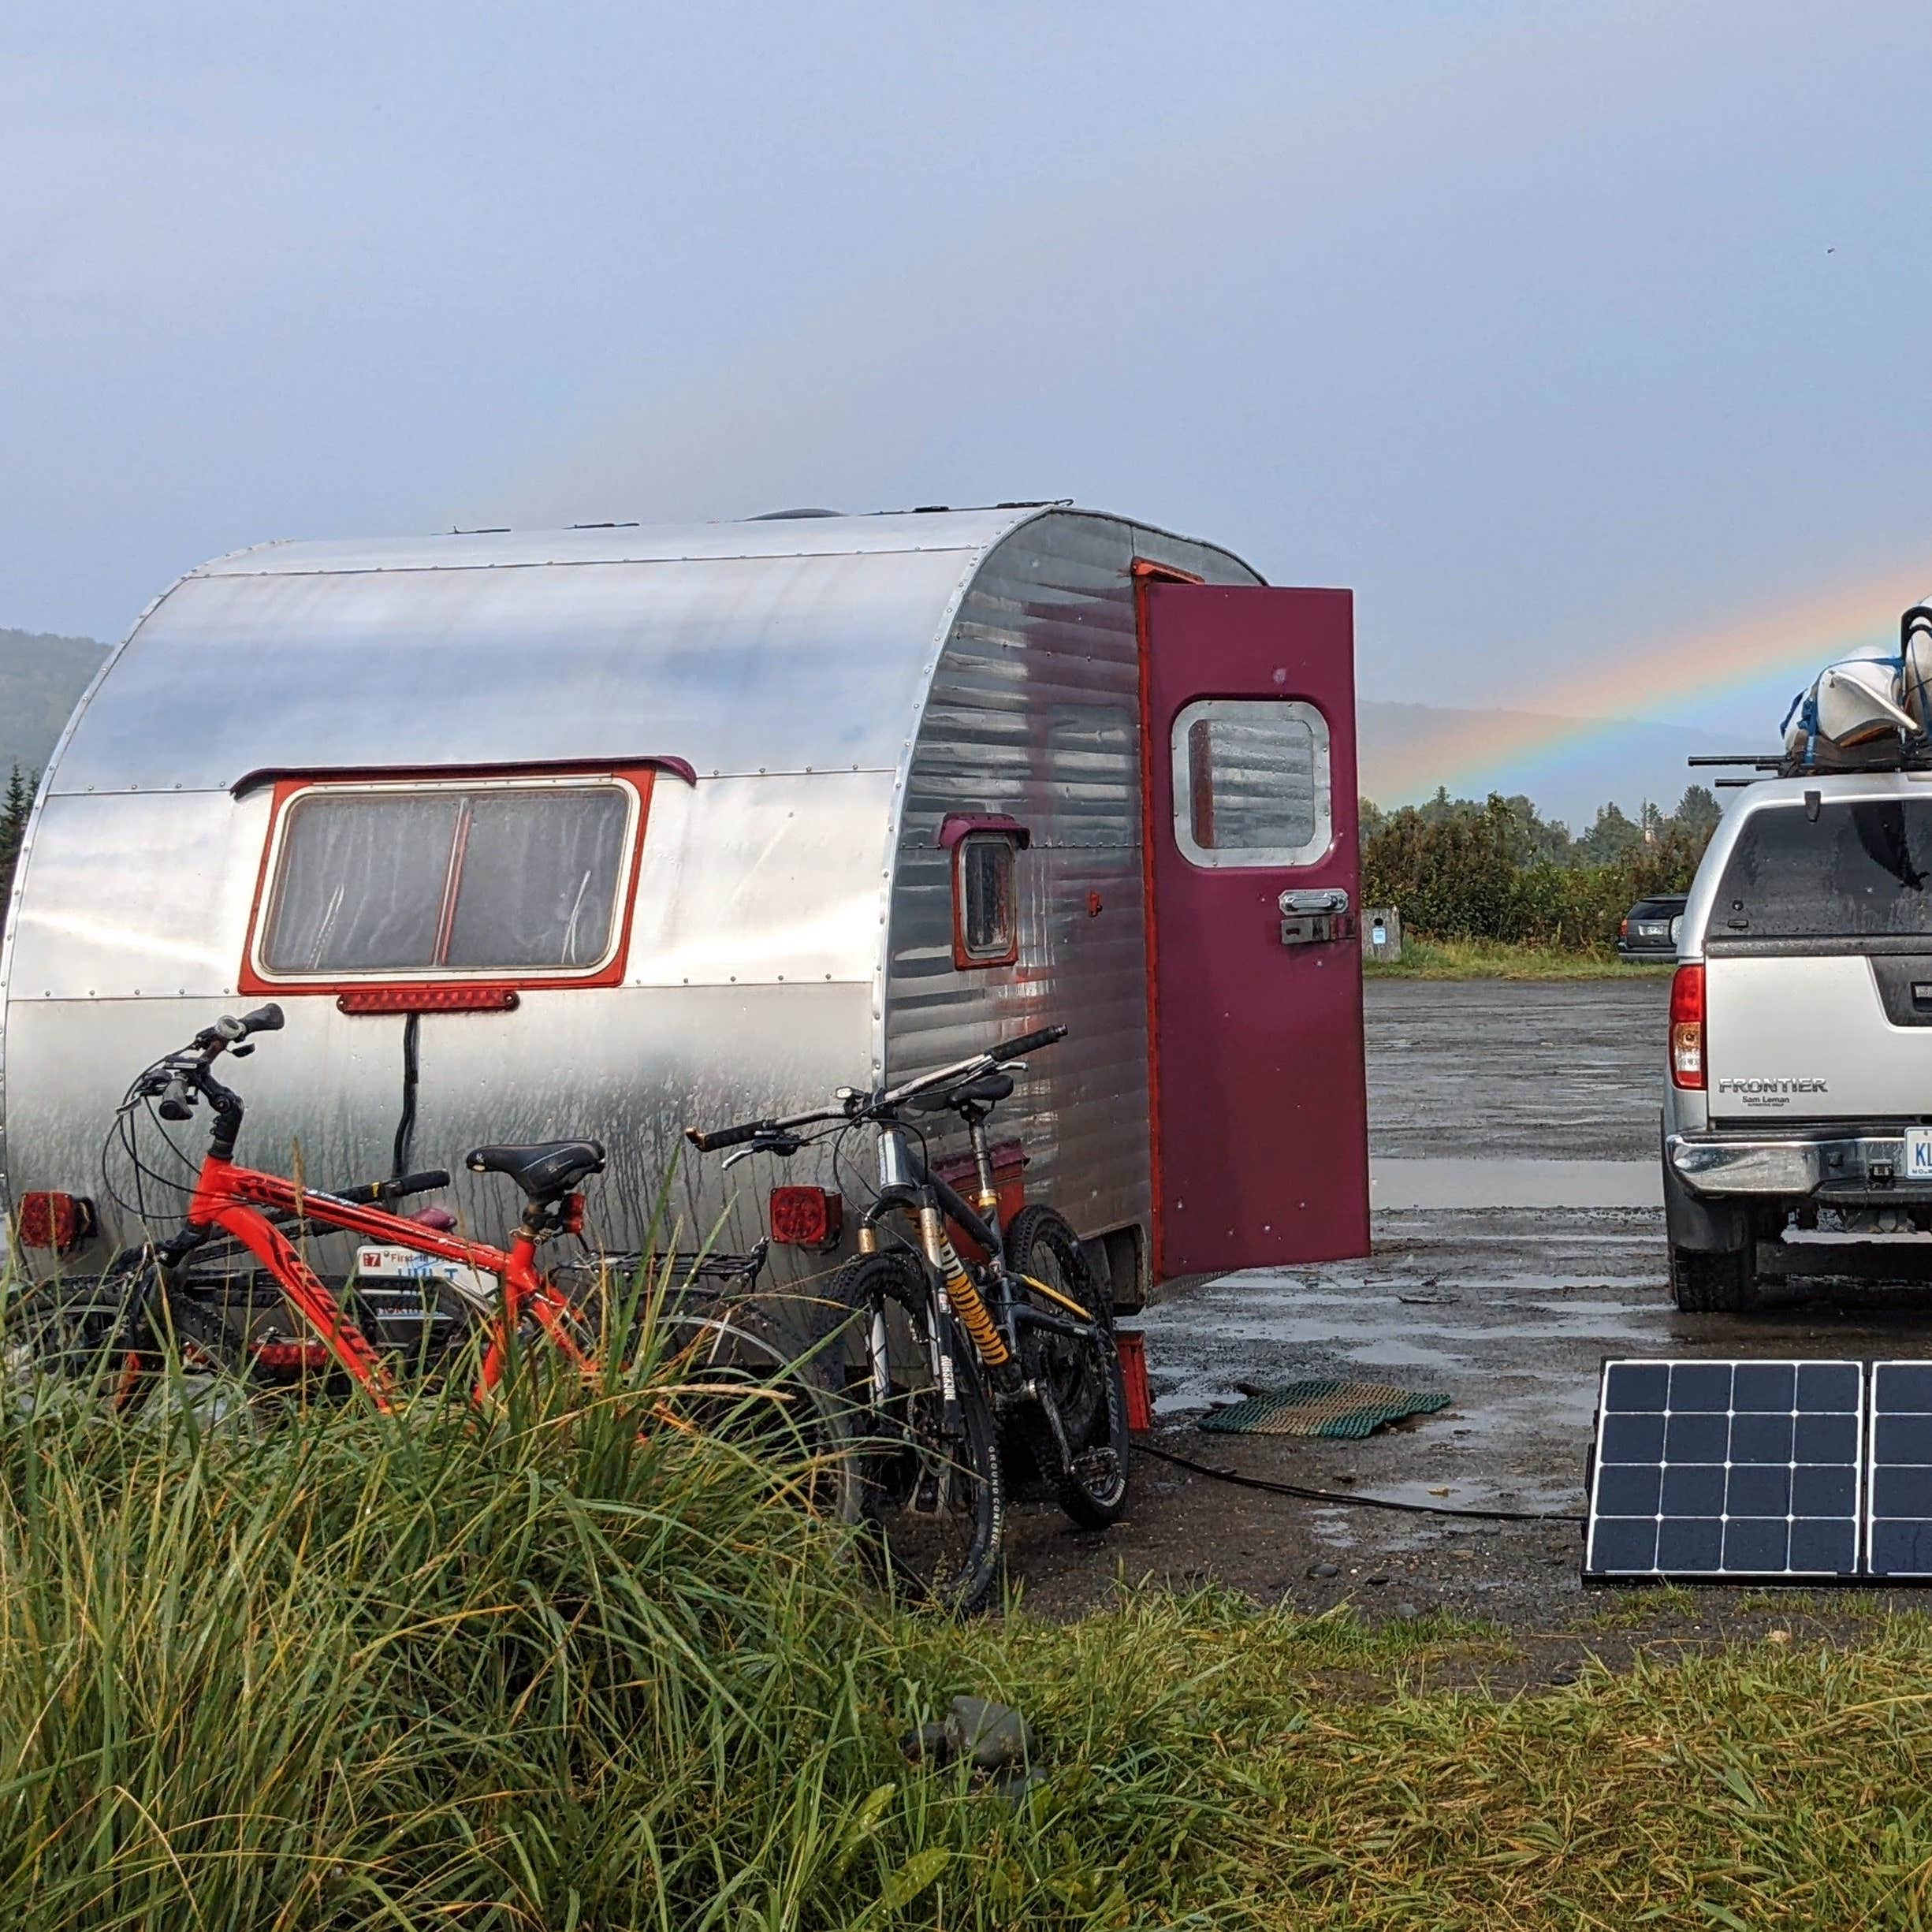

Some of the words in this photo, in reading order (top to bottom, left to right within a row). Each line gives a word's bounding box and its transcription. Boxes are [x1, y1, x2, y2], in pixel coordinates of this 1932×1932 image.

[1718, 1078, 1828, 1093] FRONTIER
[391, 1253, 414, 1263] First
[988, 1446, 1000, 1495] GROUND
[990, 1498, 1001, 1545] CONTROL
